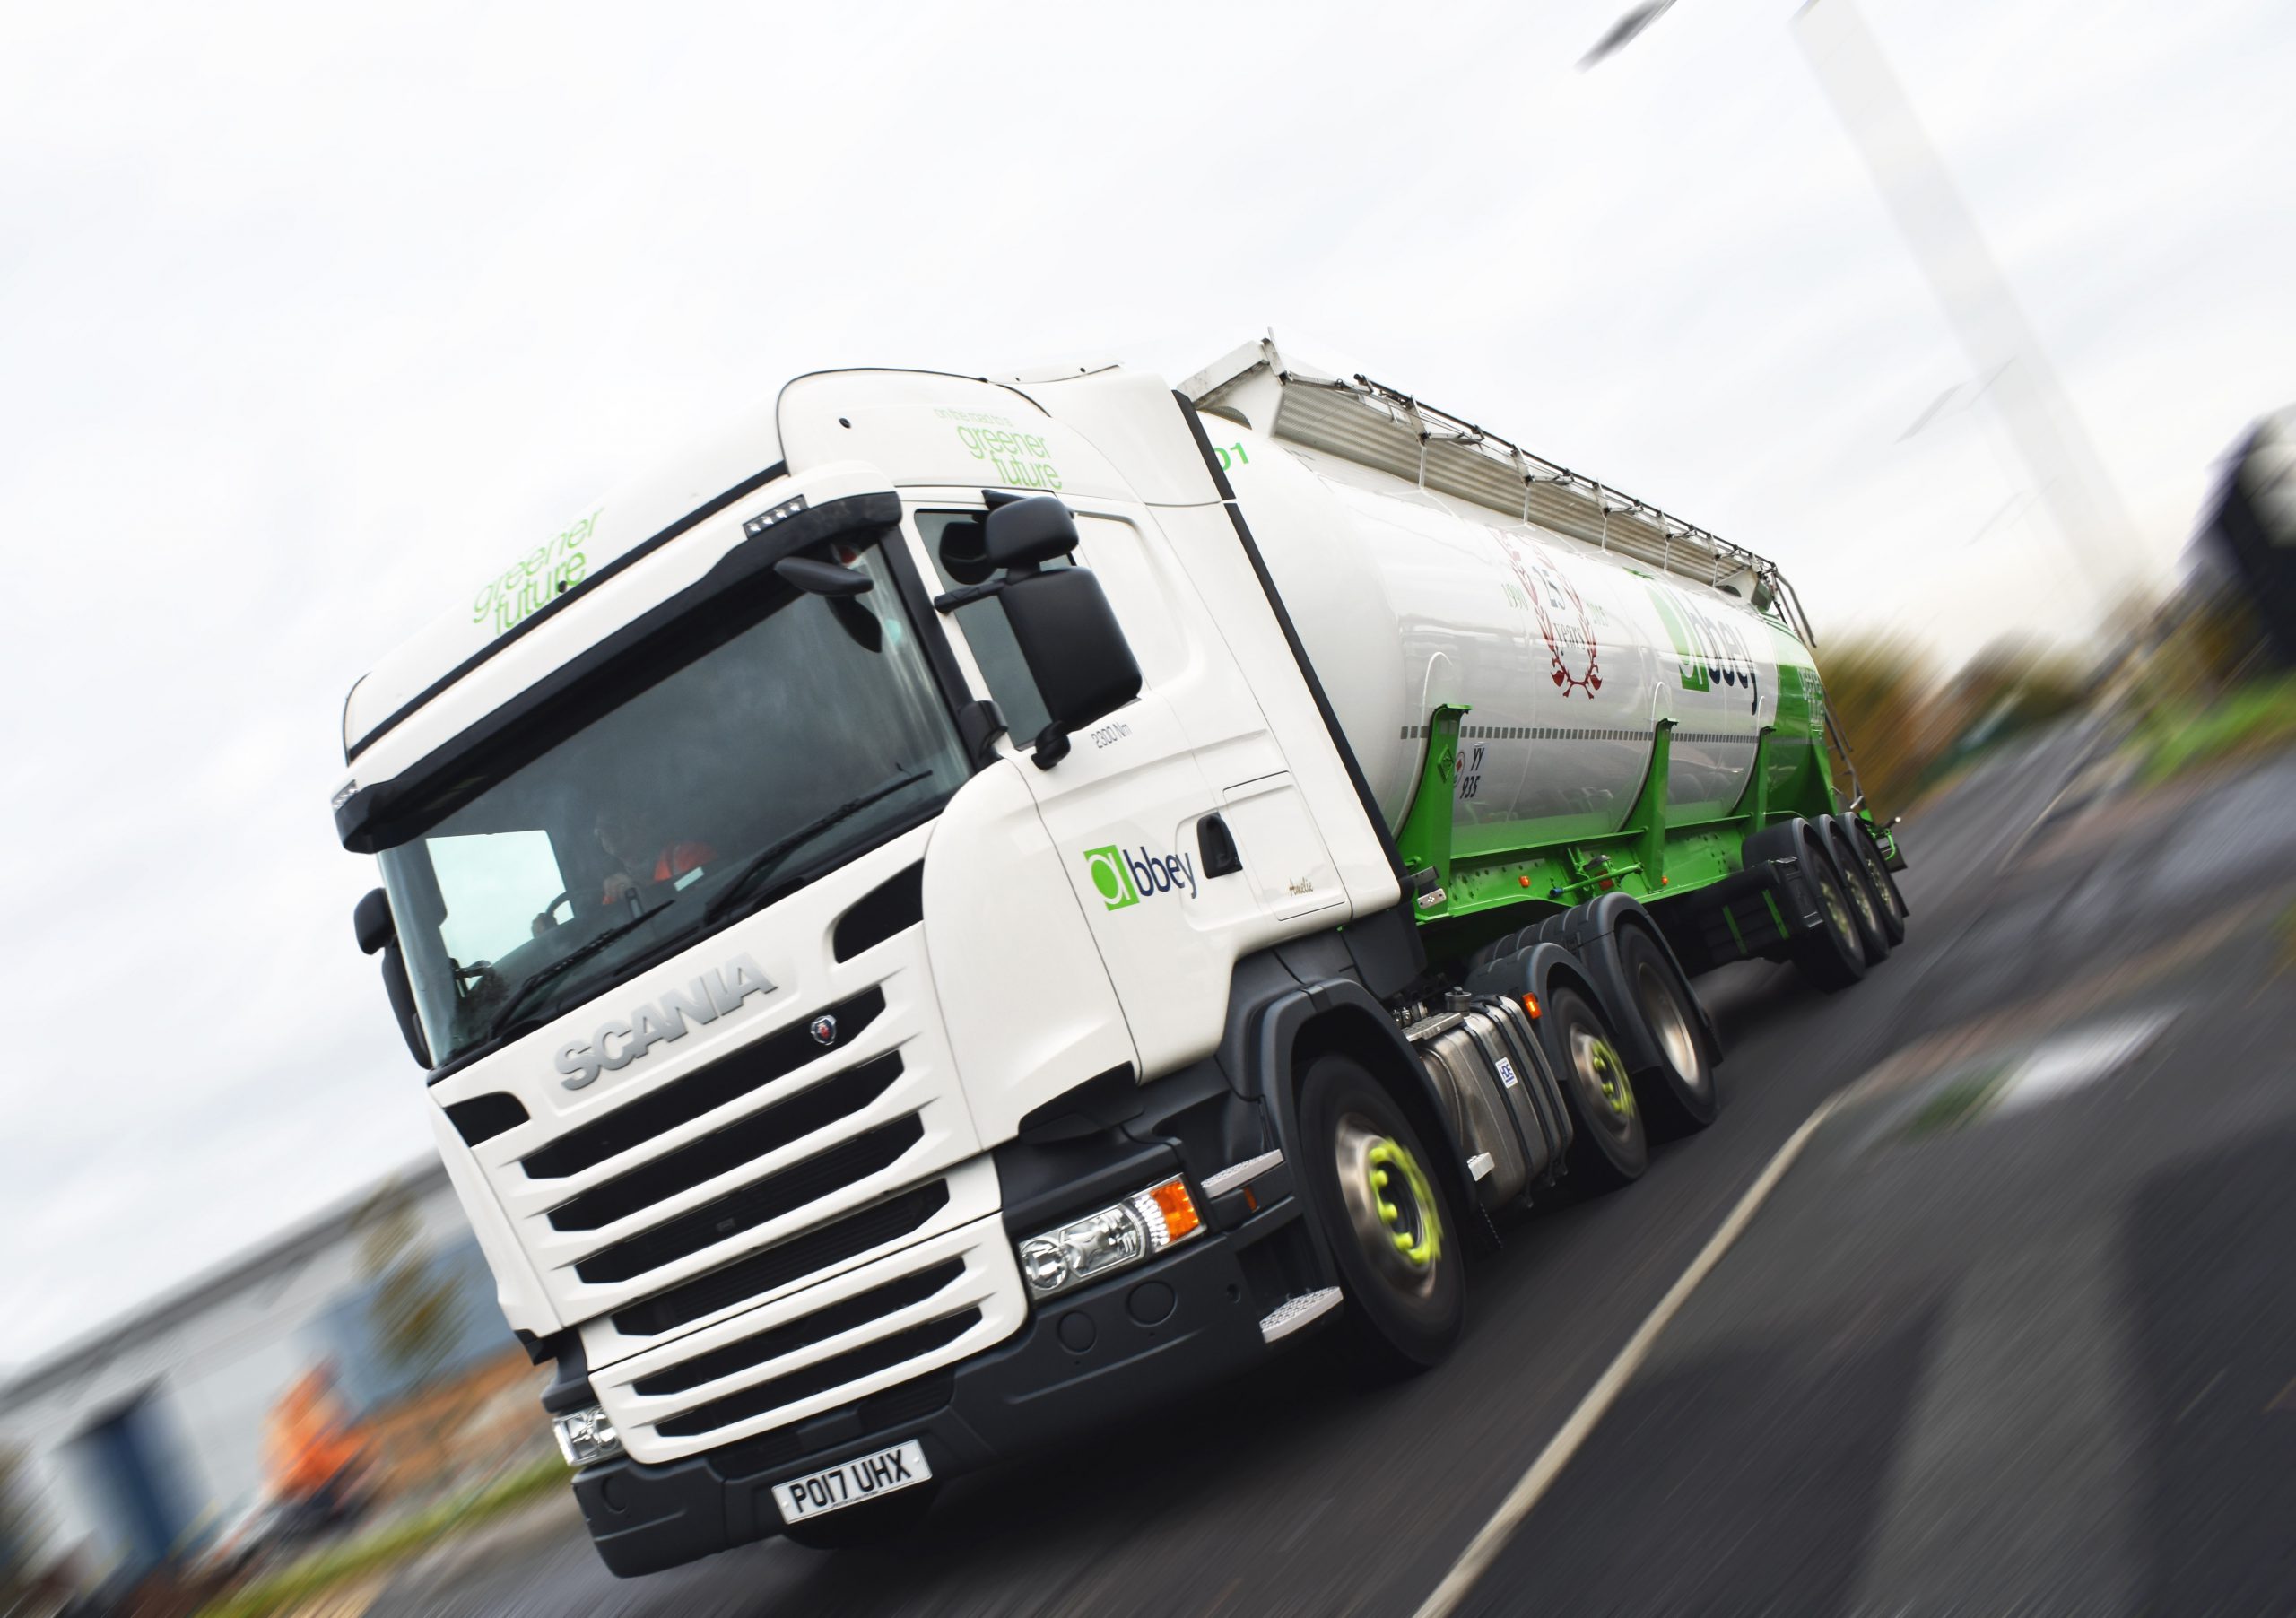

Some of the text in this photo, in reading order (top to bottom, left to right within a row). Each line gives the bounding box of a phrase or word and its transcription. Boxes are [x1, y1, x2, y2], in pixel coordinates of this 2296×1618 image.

[956, 425, 1051, 459] greener
[989, 449, 1063, 490] future
[473, 506, 605, 624] greener
[495, 552, 587, 636] future
[1639, 570, 1758, 716] abbey
[1091, 726, 1118, 749] 2300
[1470, 747, 1485, 772] YY
[1459, 775, 1481, 800] 935
[1083, 844, 1198, 912] abbey
[554, 951, 778, 1092] SCANIA
[789, 1469, 848, 1513] PO17
[851, 1449, 912, 1493] UHX
